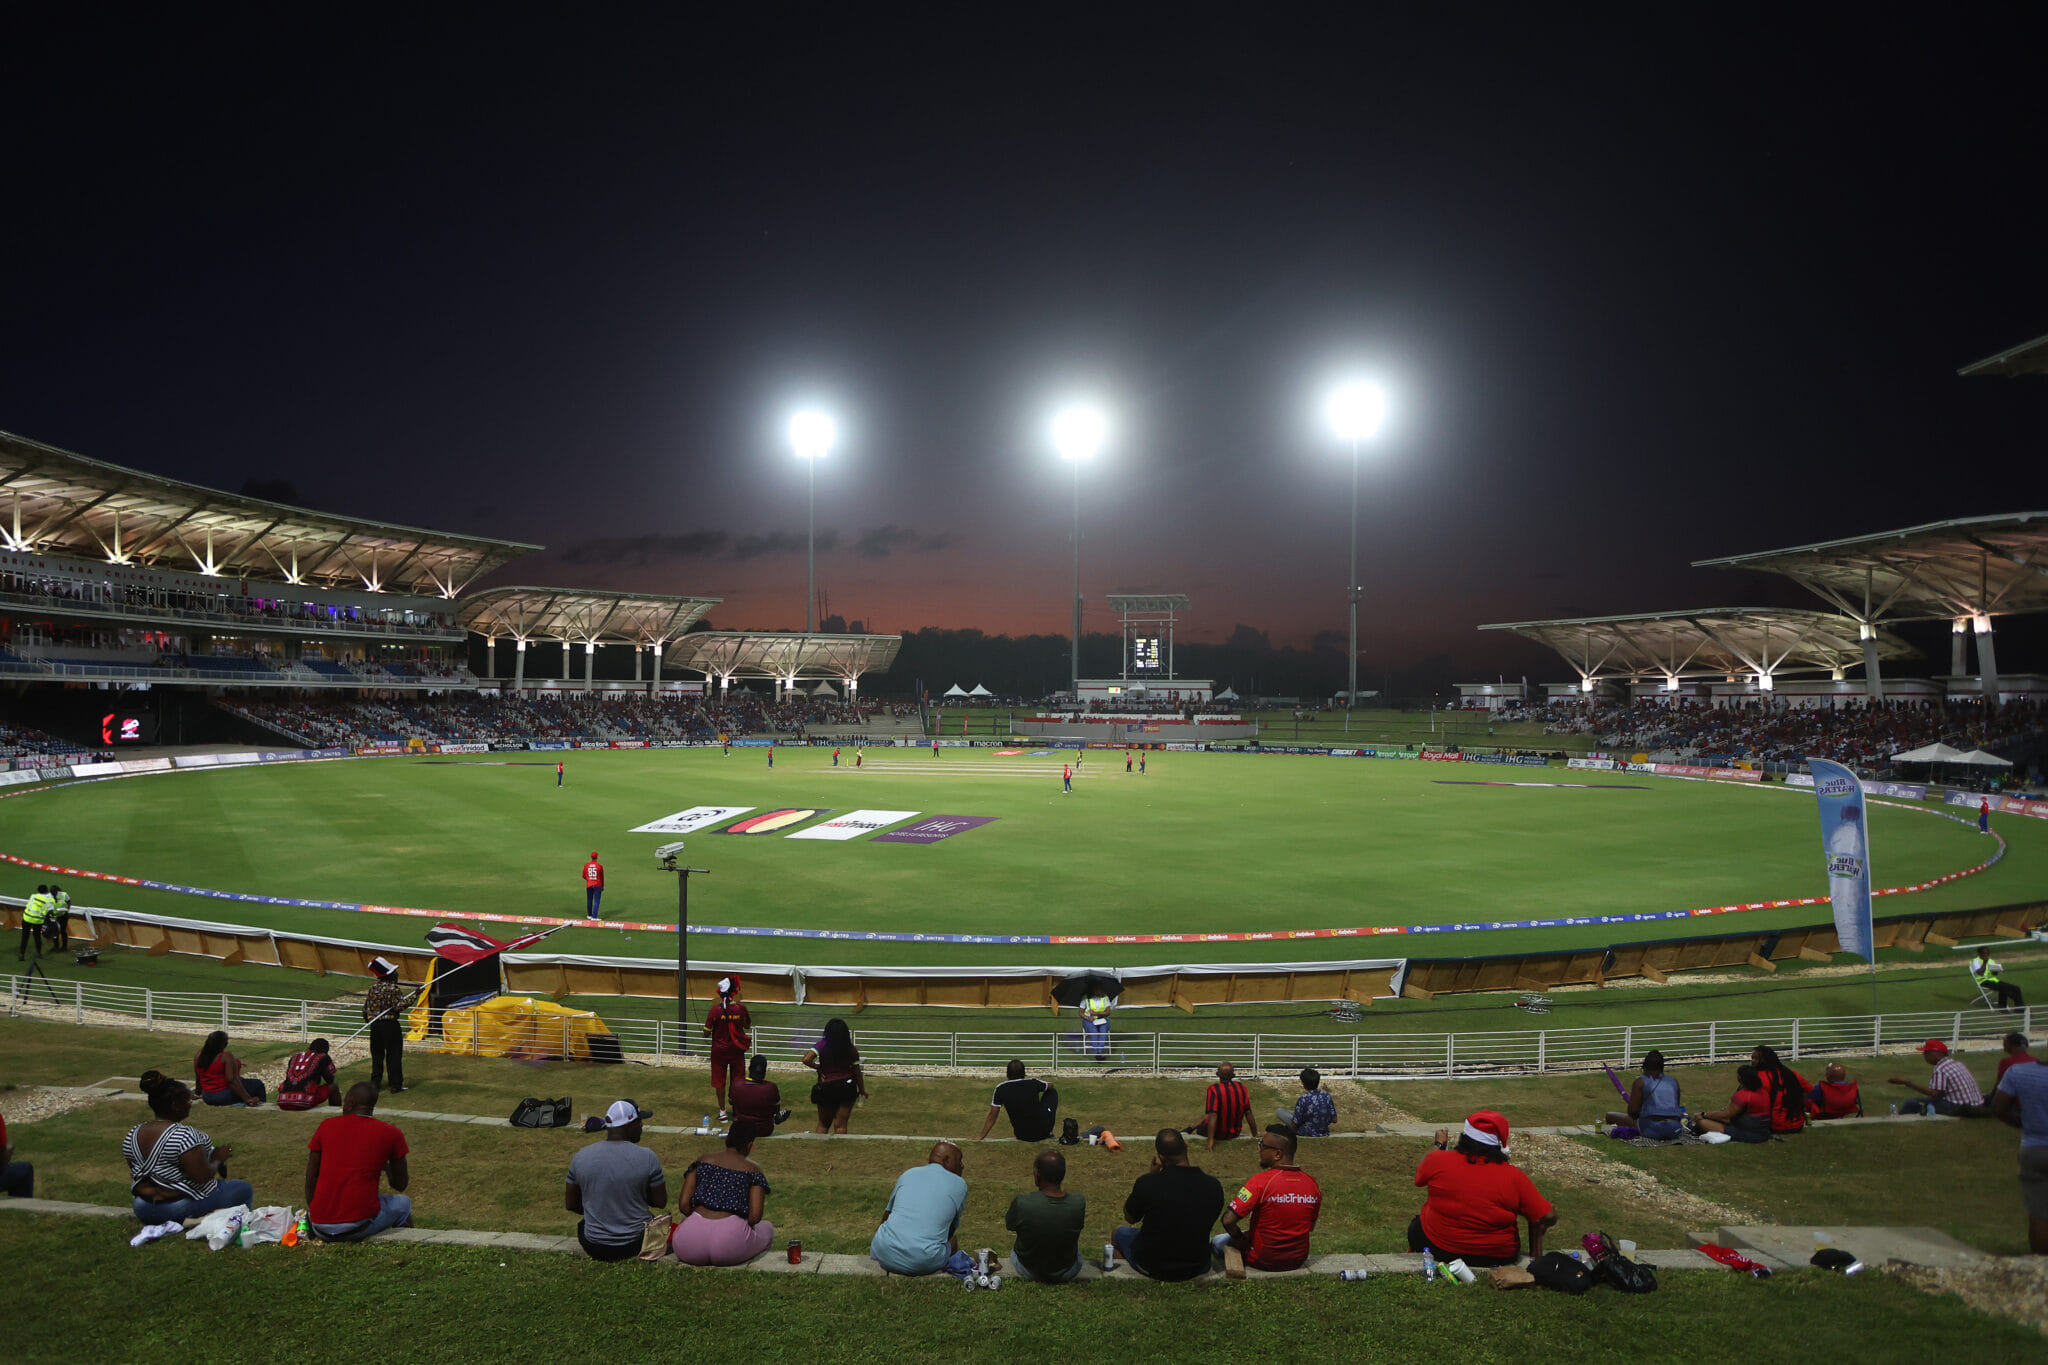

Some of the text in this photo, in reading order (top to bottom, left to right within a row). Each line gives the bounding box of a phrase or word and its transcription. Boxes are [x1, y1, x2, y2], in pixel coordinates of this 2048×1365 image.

[2, 556, 45, 569] BRIAN
[59, 564, 93, 575] LARA
[105, 570, 163, 581] CRICKET
[175, 578, 230, 590] ACADEMY
[1423, 752, 1442, 760] Royal
[1462, 753, 1481, 762] IHG
[1505, 755, 1523, 763] IHG
[41, 766, 73, 780] macron
[913, 820, 969, 832] IHG
[588, 867, 598, 877] 85
